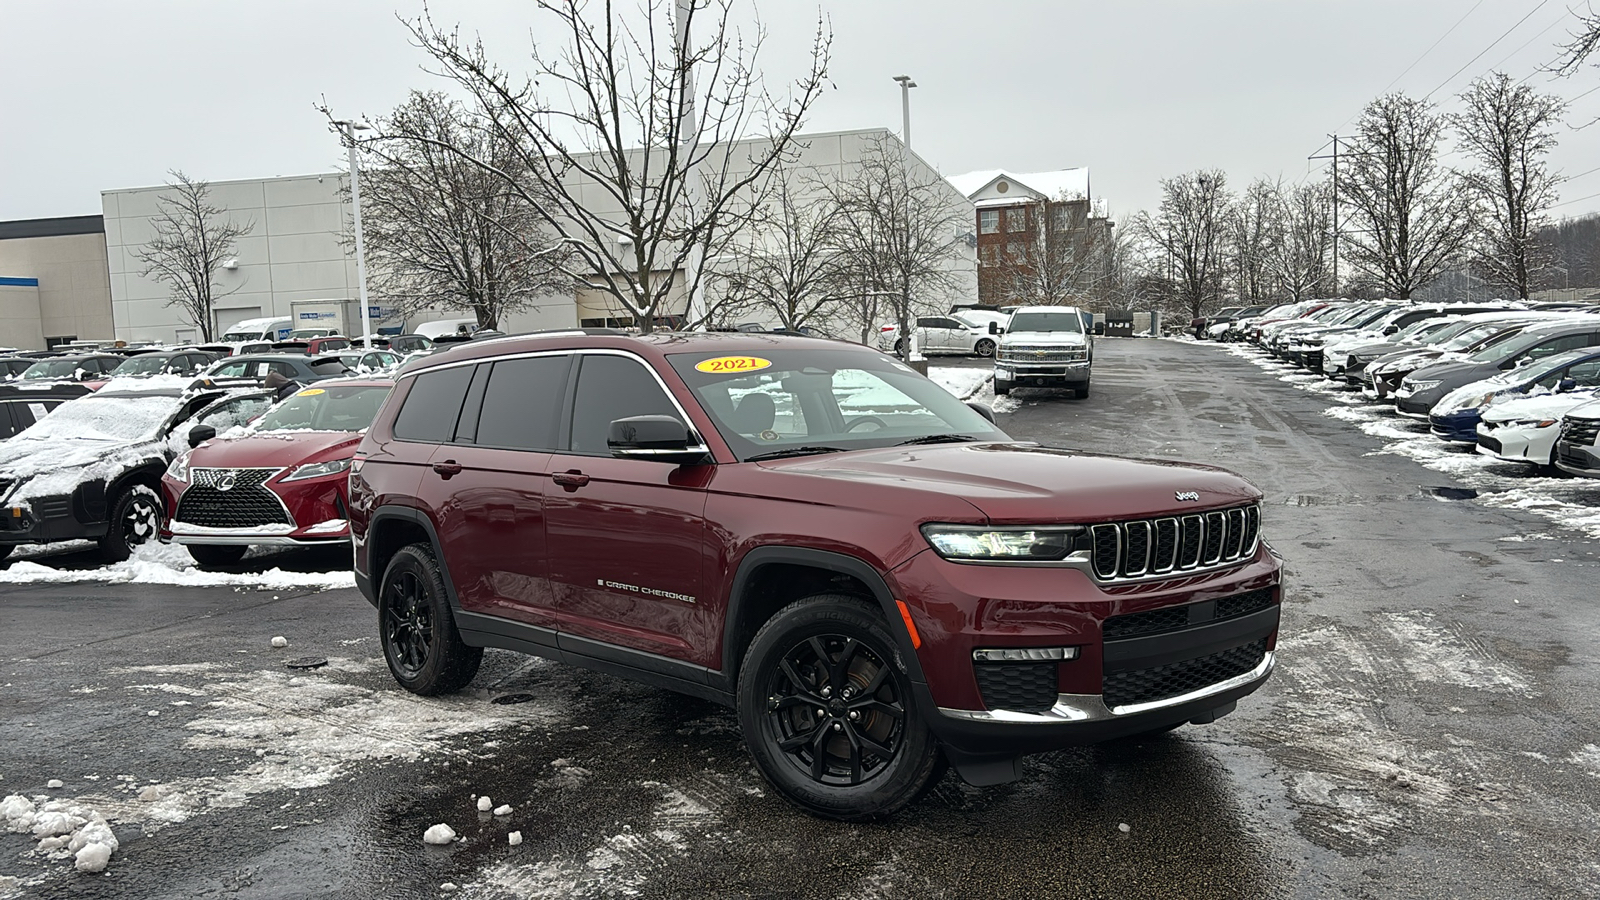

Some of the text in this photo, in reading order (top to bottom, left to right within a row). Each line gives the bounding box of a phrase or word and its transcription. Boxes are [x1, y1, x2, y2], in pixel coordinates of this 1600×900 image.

[711, 358, 758, 371] 2021
[1175, 490, 1199, 501] Jeep
[606, 580, 696, 604] GRAND CHEROKEE
